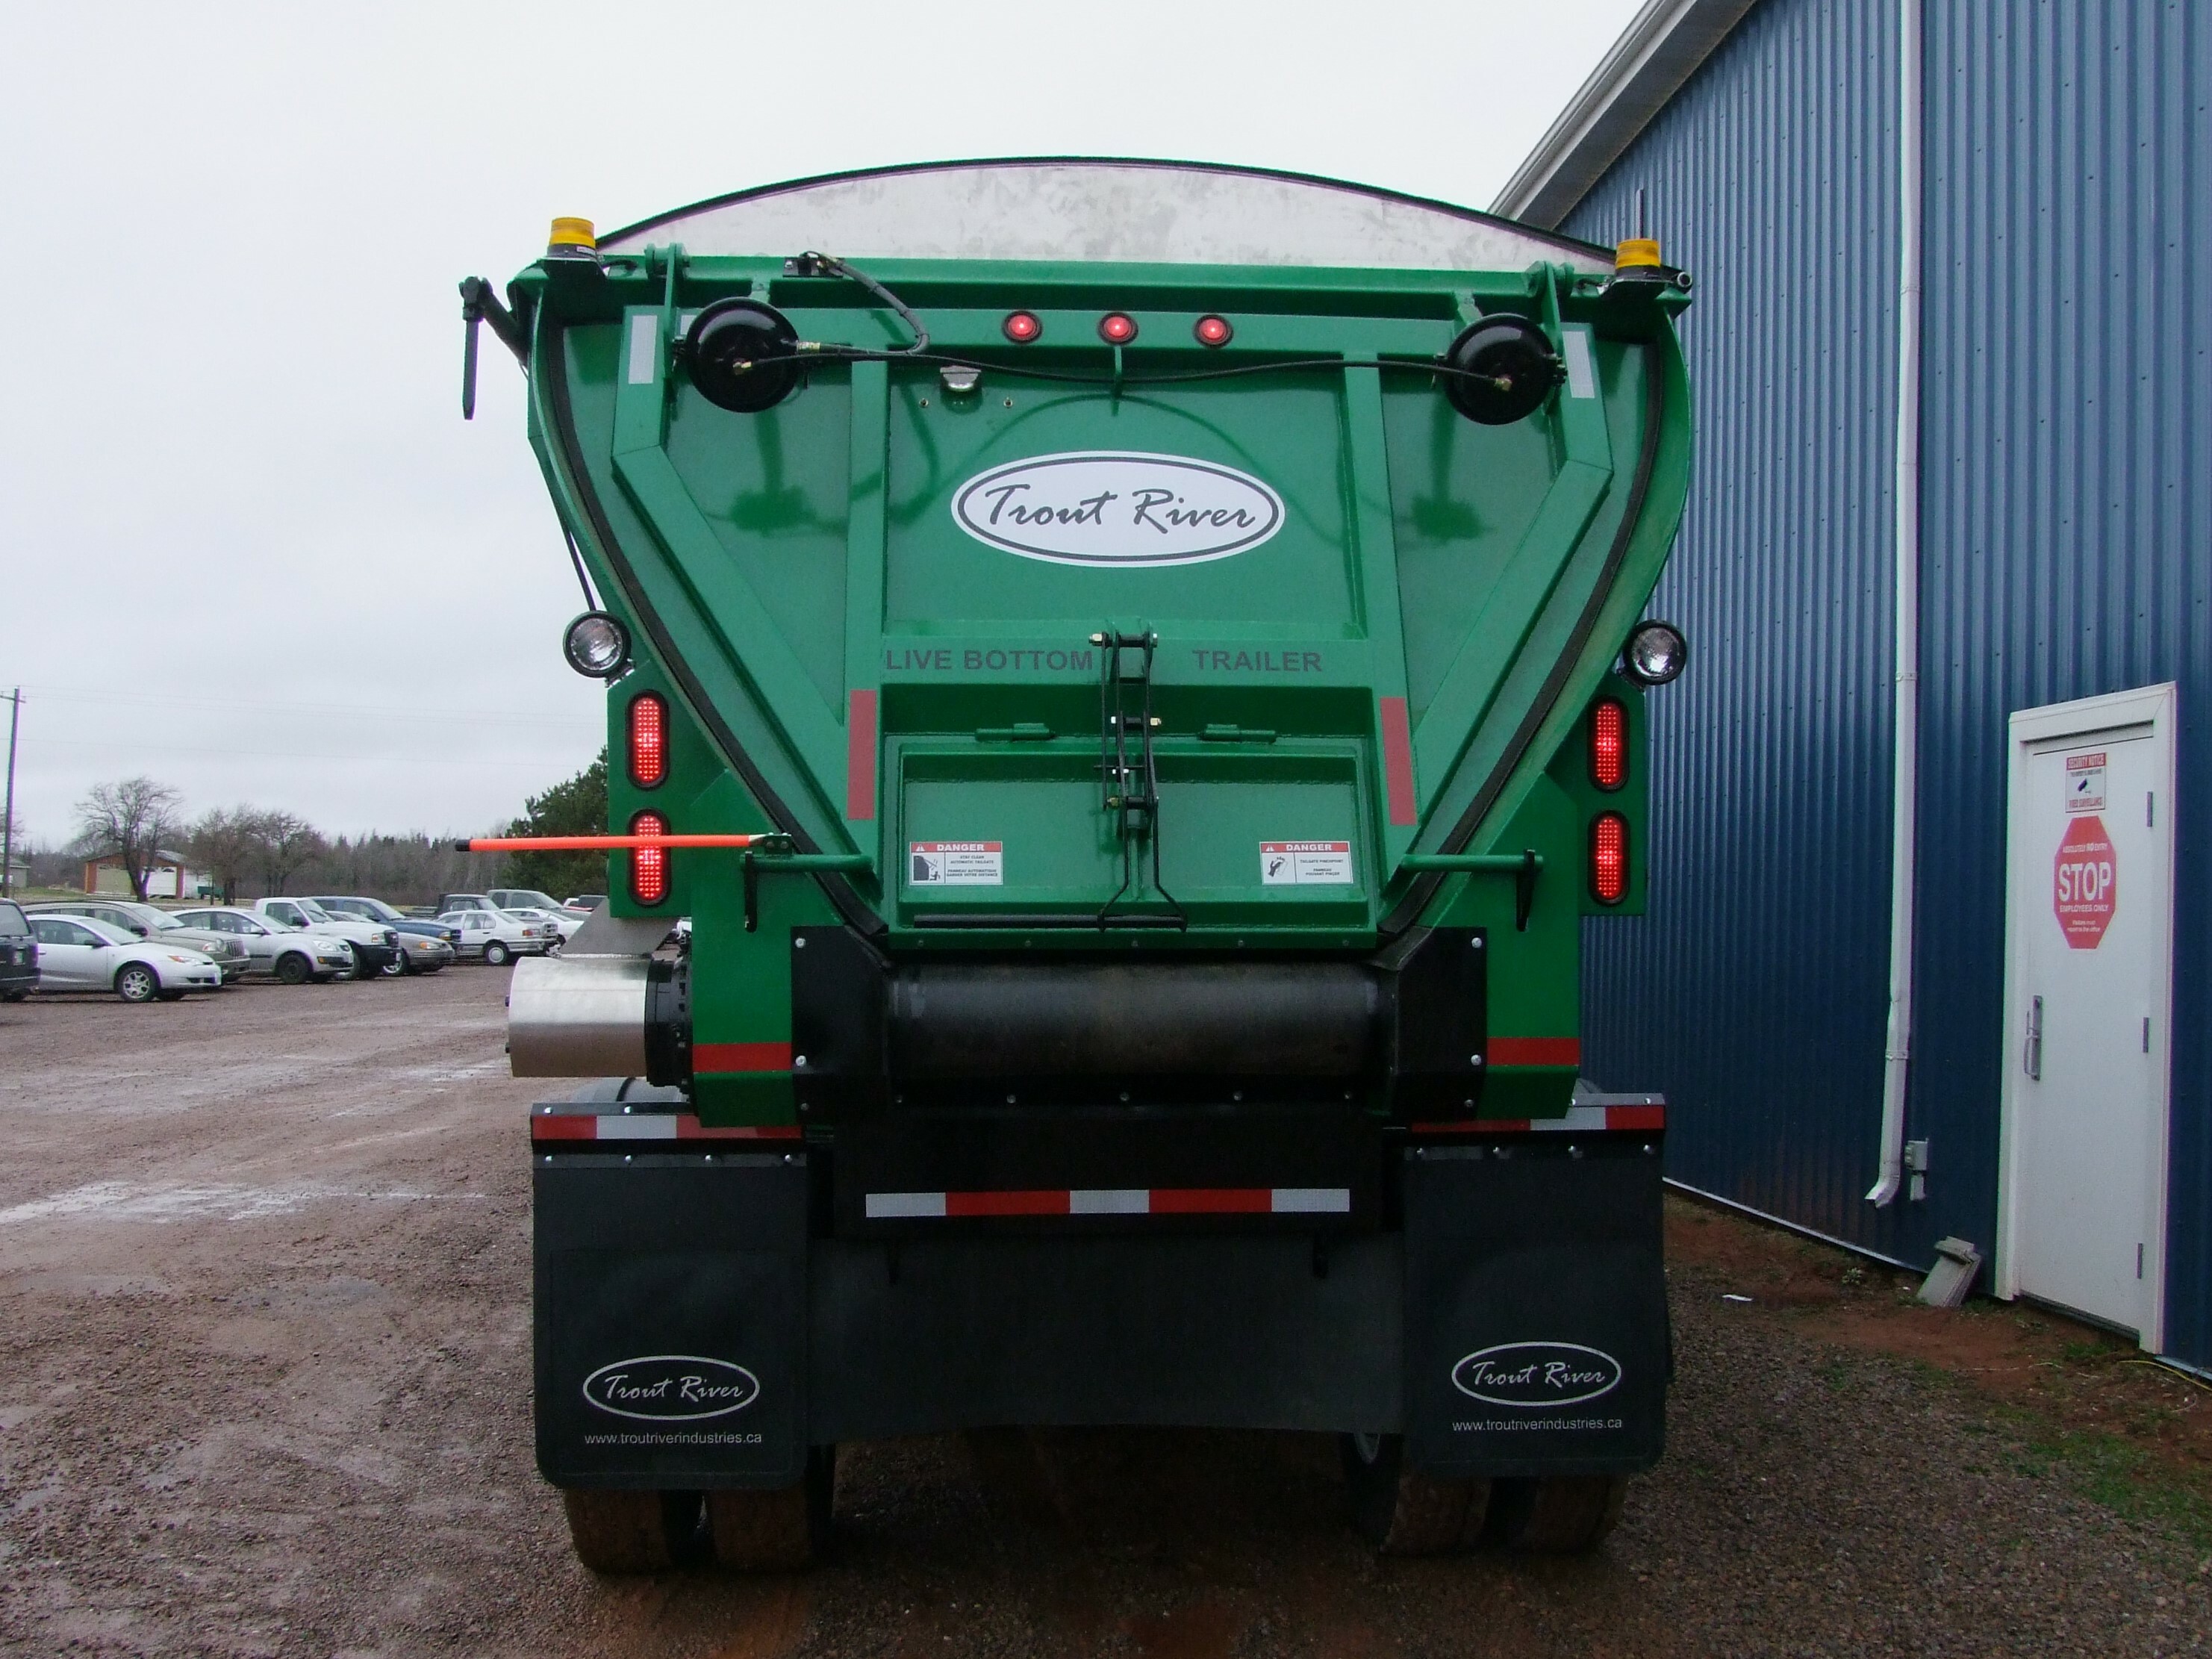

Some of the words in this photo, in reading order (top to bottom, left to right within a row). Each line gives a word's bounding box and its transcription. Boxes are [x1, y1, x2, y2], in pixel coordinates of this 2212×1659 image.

[985, 483, 1118, 525] Trout
[1132, 488, 1256, 535] River
[886, 650, 952, 670] LIVE
[964, 650, 1093, 671] BOTTOM
[1193, 649, 1323, 672] TRAILER
[2058, 862, 2111, 901] STOP
[2059, 904, 2093, 913] EMPLOYEES
[2093, 903, 2109, 912] ONLY
[1472, 1361, 1538, 1386] Trout
[1544, 1361, 1606, 1388] River
[605, 1375, 673, 1399] Trout
[680, 1375, 744, 1402] River
[1452, 1418, 1623, 1431] www.troutriverindustries.ca
[585, 1432, 762, 1445] www.troutriverindustries.ca
